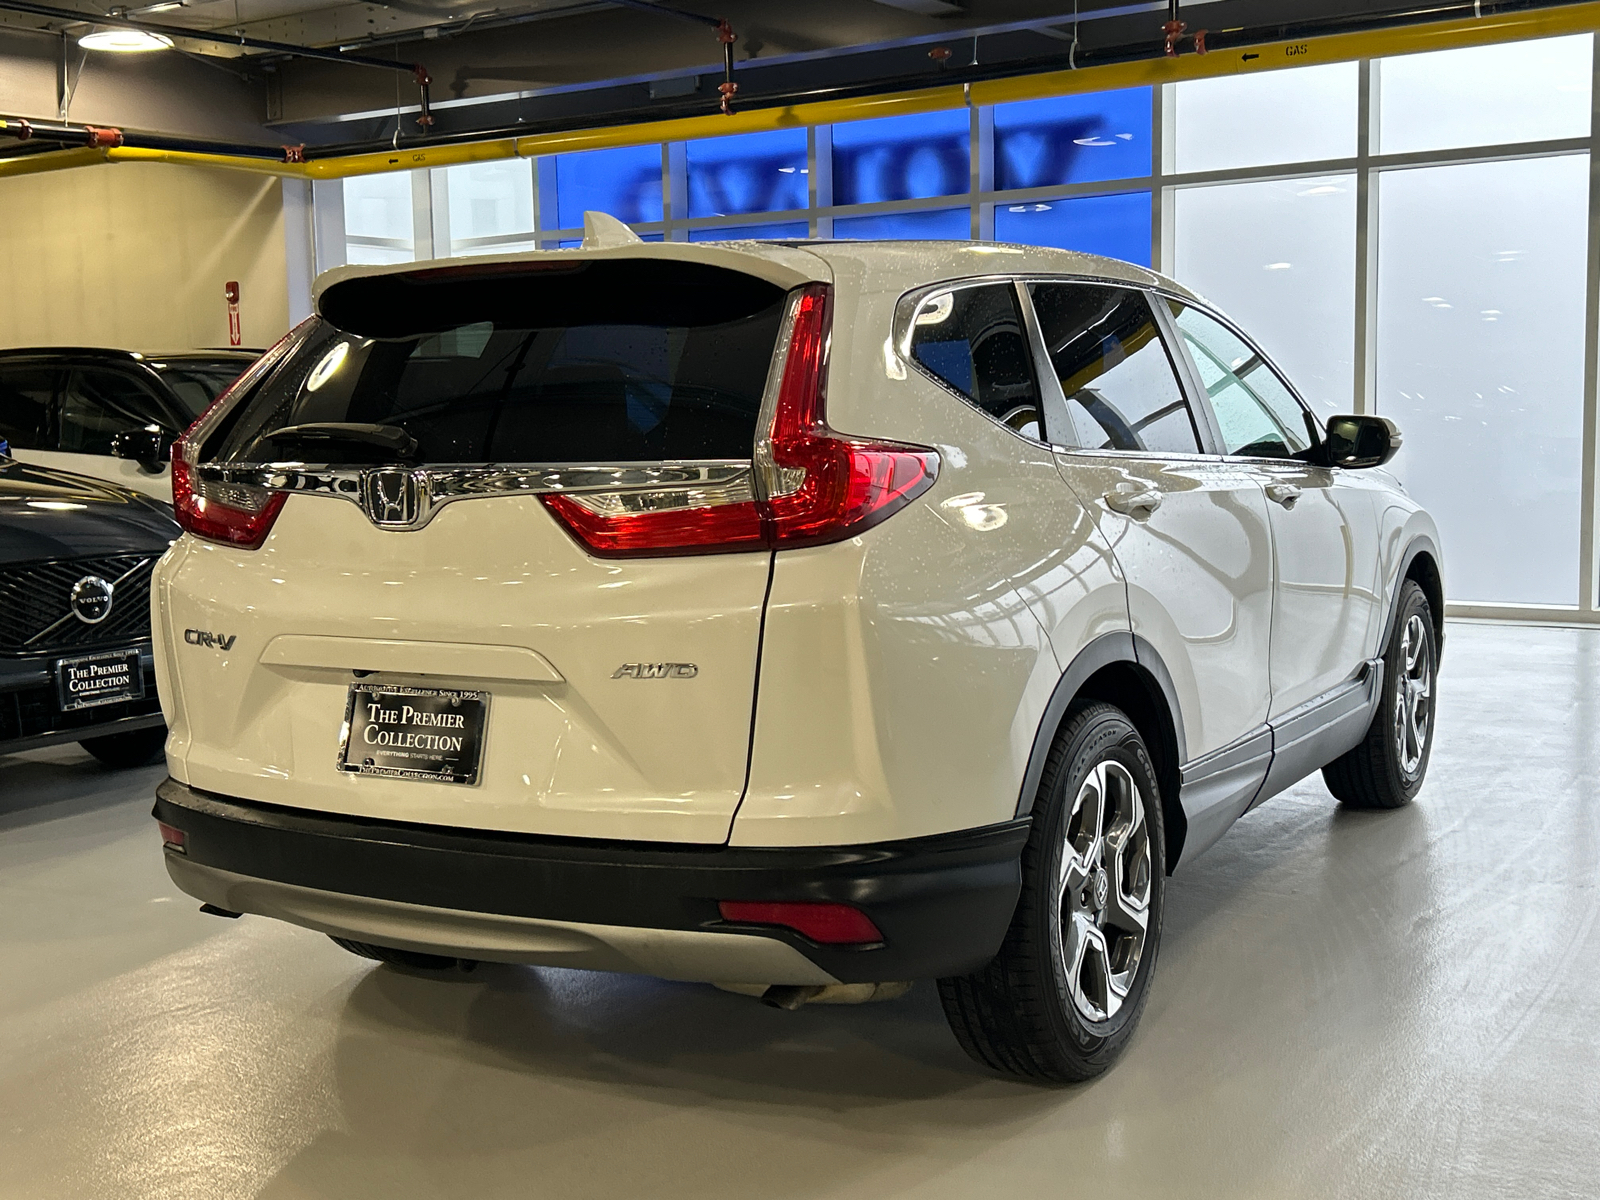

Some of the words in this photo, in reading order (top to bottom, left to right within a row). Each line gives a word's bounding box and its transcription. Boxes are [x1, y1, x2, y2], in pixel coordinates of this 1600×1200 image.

[1285, 44, 1308, 57] GAS
[412, 153, 426, 162] GAS
[79, 595, 109, 604] VOLVO
[183, 628, 237, 651] CR-V
[67, 667, 90, 680] THE
[90, 663, 129, 677] PREMIER
[609, 662, 699, 679] AWD
[69, 675, 130, 692] COLLECTION
[460, 691, 479, 699] 1995
[367, 702, 399, 724] THE
[400, 705, 465, 729] PREMIER
[363, 724, 463, 752] COLLECTION
[376, 749, 410, 758] EVERYTHING
[409, 752, 429, 760] STARTS
